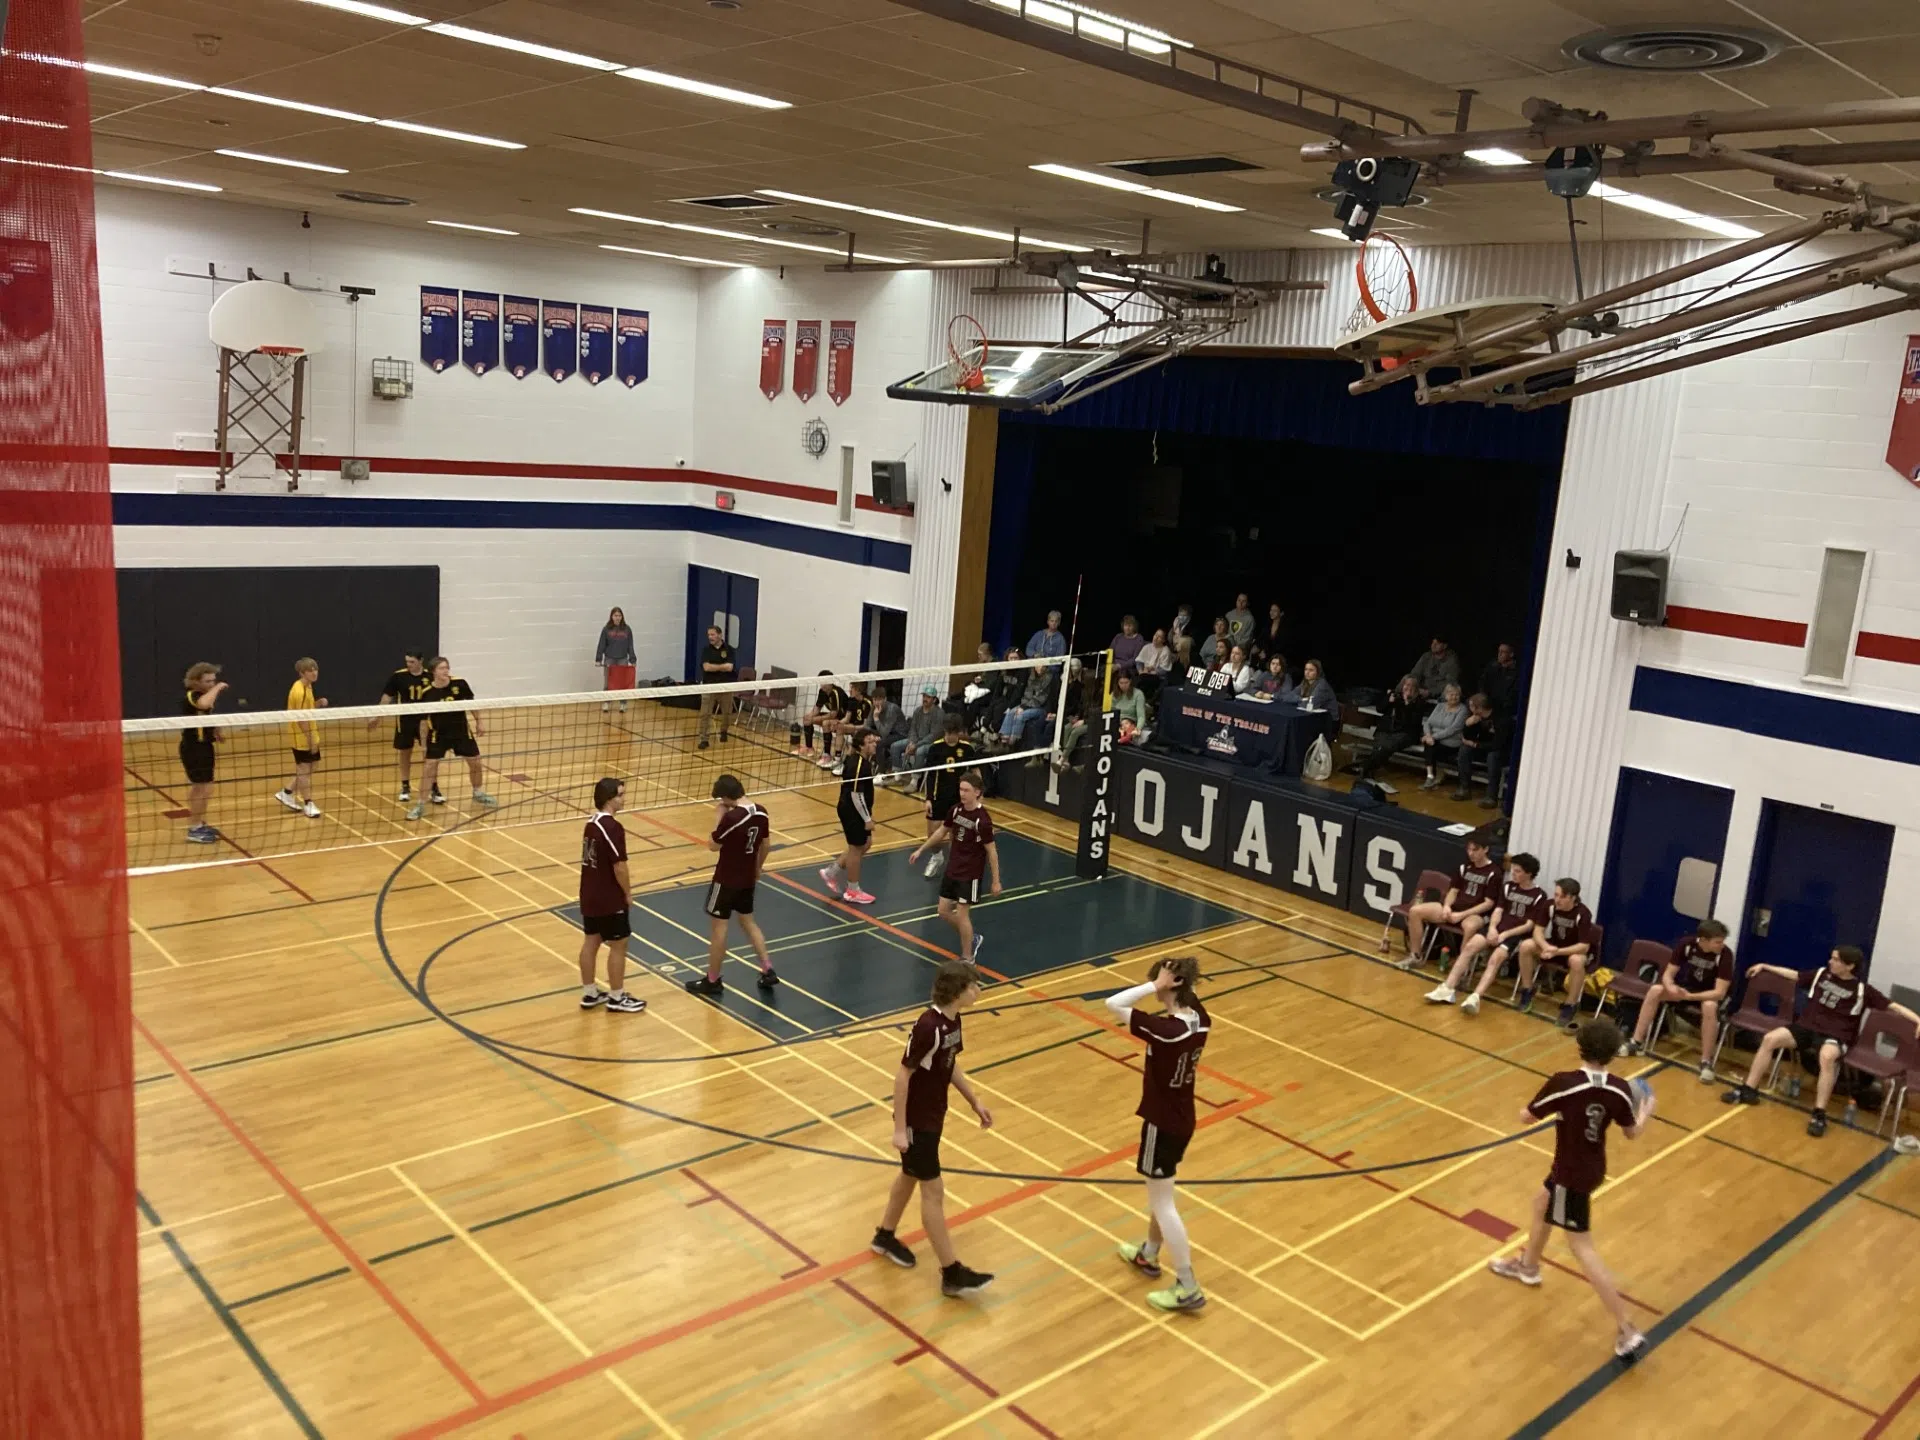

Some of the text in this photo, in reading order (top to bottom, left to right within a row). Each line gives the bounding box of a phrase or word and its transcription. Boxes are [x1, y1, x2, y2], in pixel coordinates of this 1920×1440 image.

[1209, 674, 1223, 688] 05
[408, 685, 422, 700] 11
[1234, 718, 1270, 734] TROJANS
[1089, 712, 1114, 859] TROJANS
[1044, 751, 1407, 914] TOJANS
